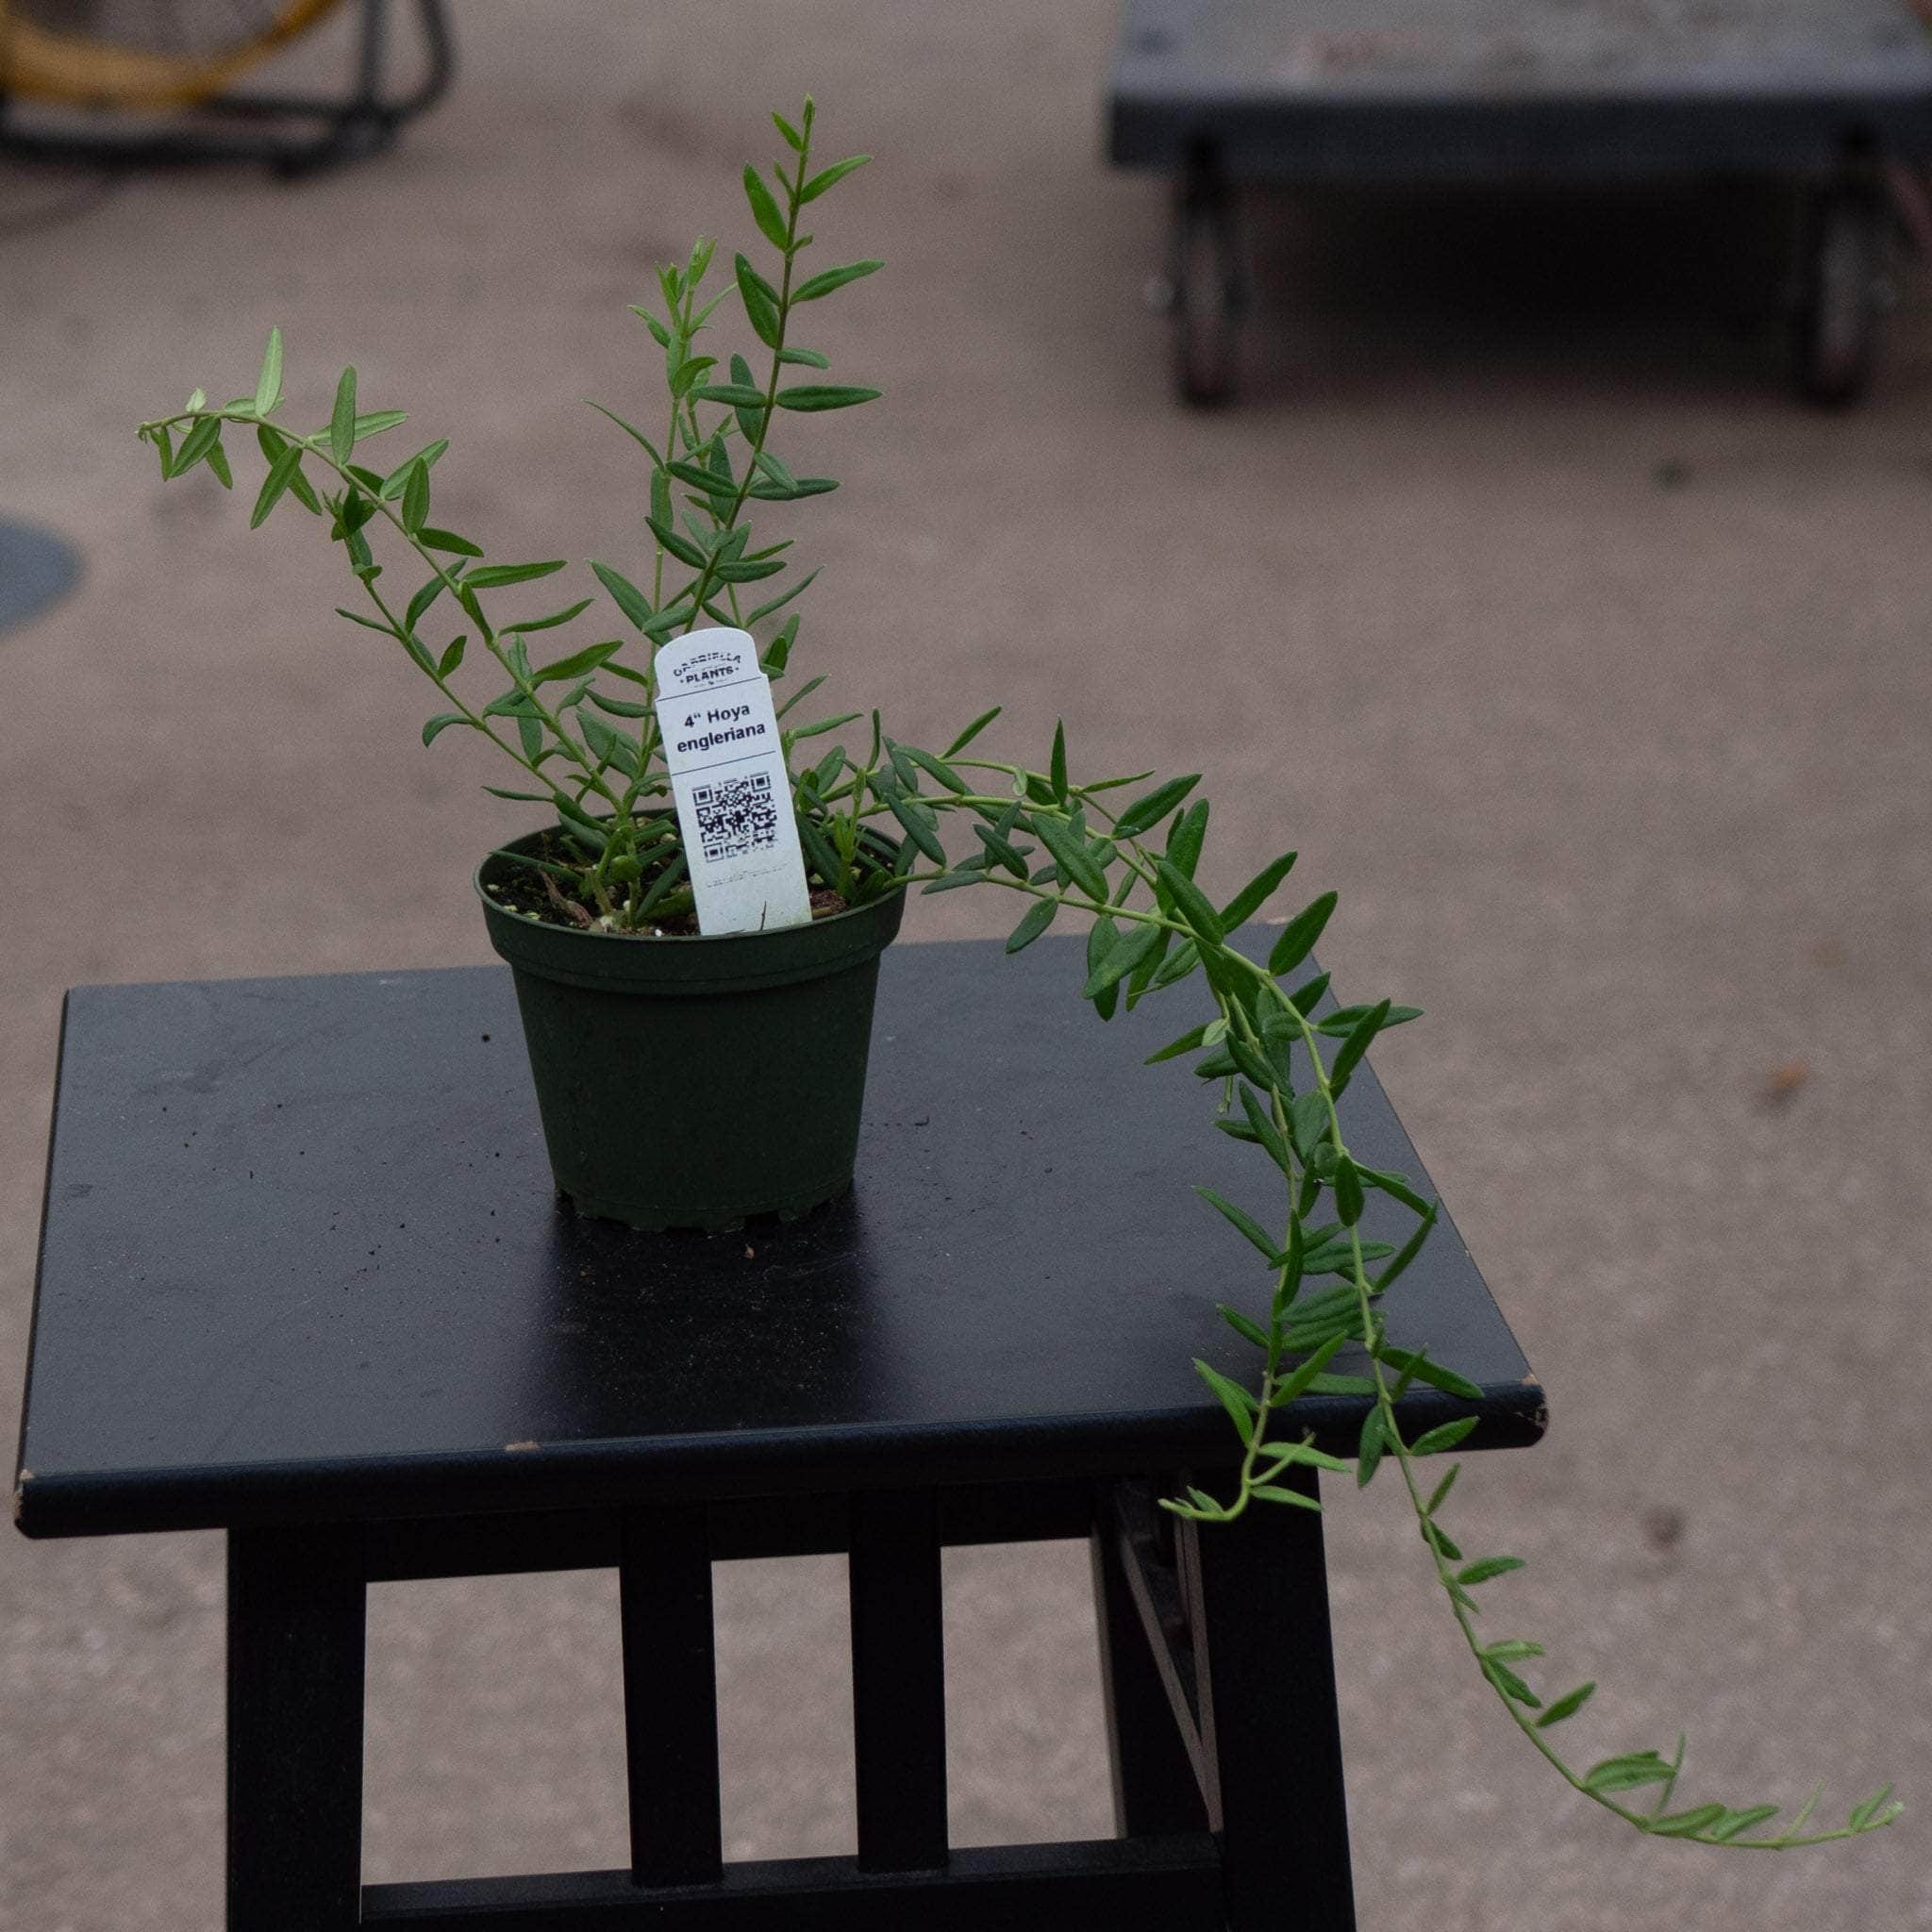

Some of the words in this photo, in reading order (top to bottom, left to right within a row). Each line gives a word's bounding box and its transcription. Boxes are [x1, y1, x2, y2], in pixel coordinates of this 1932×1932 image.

[686, 665, 734, 684] PLANTS
[707, 705, 750, 724] Hoya
[677, 724, 766, 753] engleriana
